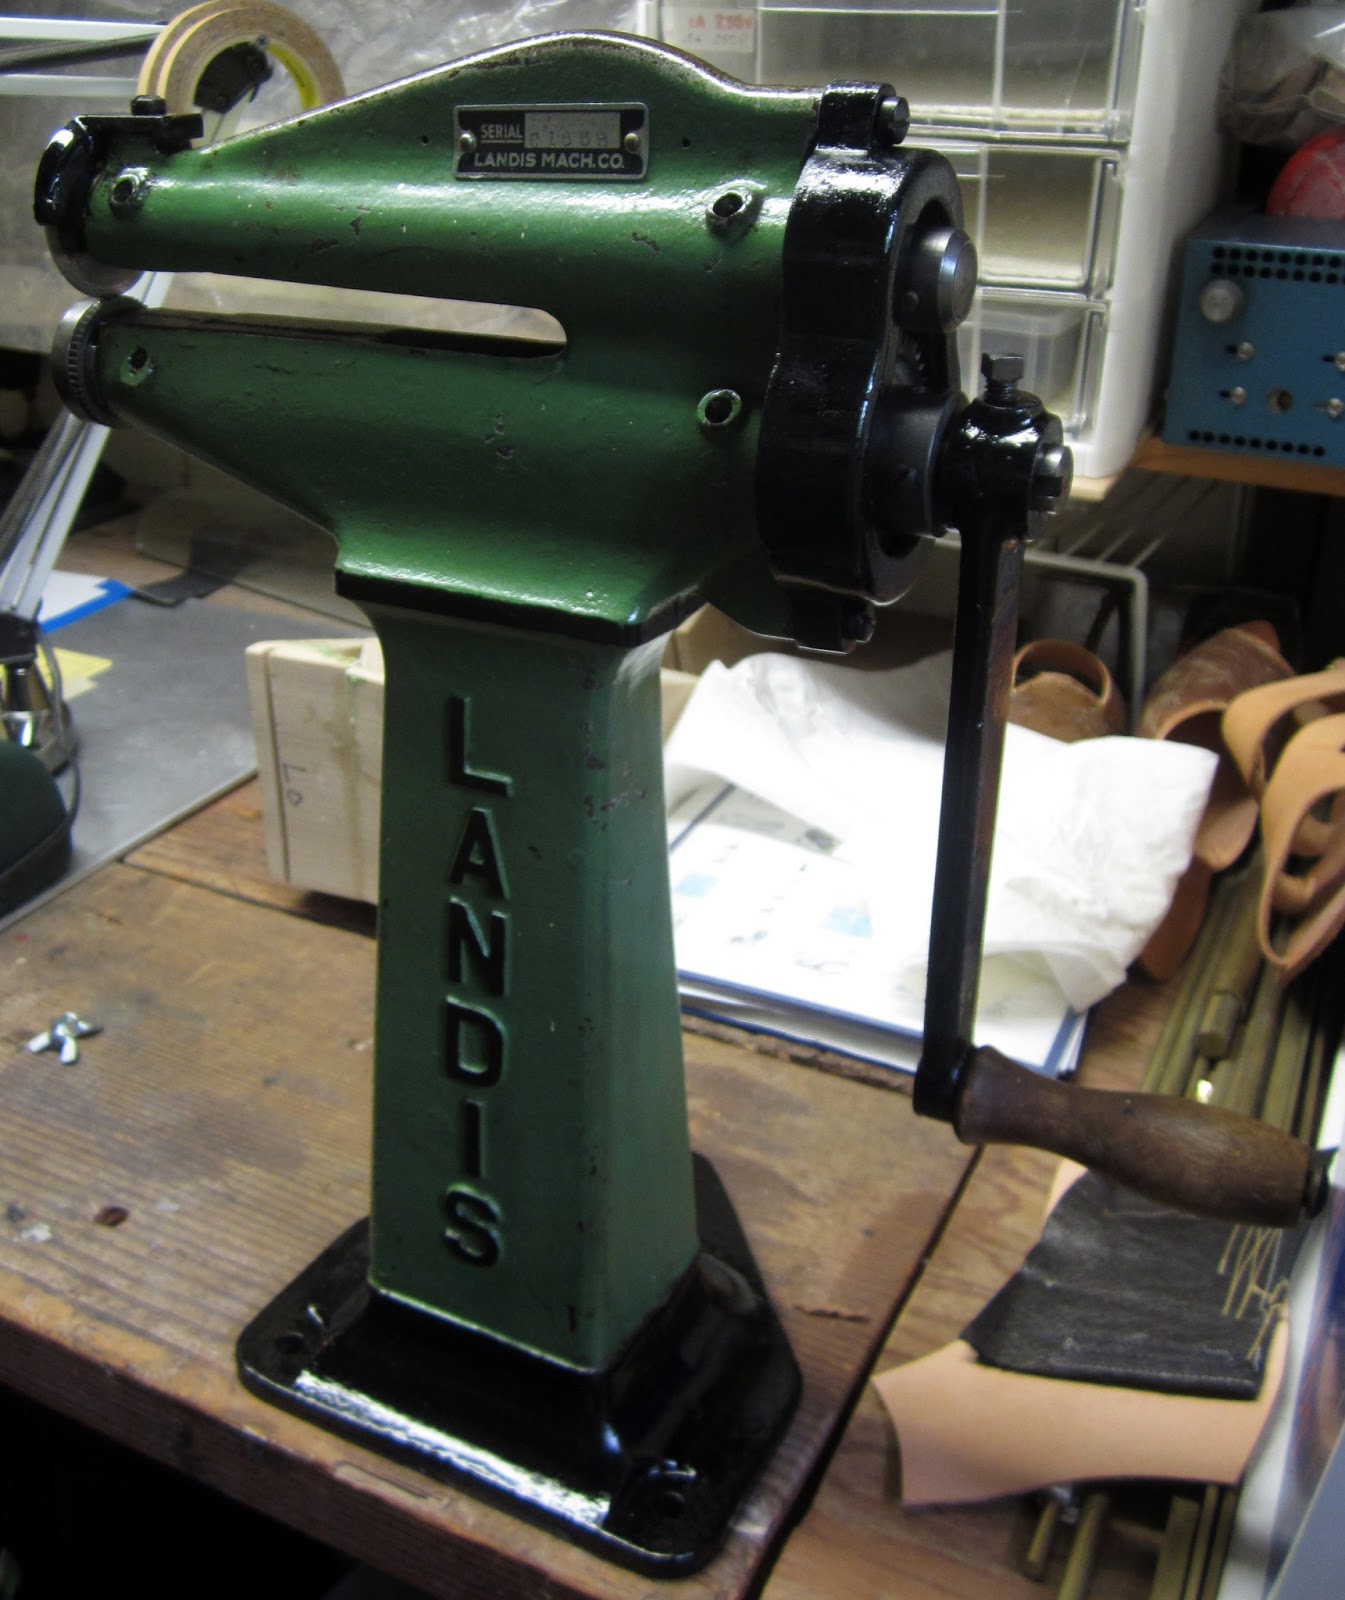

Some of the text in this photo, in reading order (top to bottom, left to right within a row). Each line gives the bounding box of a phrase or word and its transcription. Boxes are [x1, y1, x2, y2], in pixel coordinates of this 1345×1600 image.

[481, 123, 524, 140] SERIAL
[474, 152, 536, 168] LANDIS
[444, 694, 514, 1268] LANDIS
